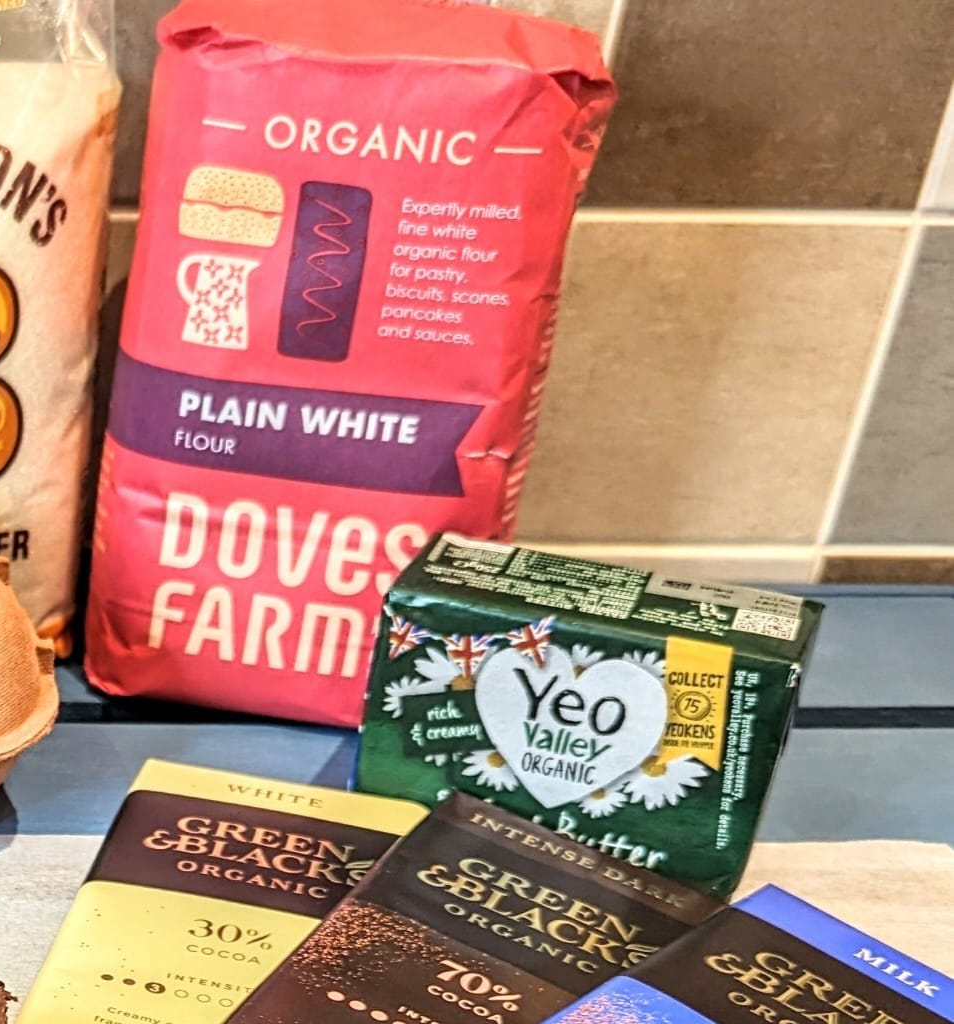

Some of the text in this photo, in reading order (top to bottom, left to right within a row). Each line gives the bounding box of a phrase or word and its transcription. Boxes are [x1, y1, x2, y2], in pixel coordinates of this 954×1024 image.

[264, 115, 476, 166] ORGANIC
[402, 198, 464, 220] Expertly
[398, 220, 477, 240] fine white
[390, 262, 410, 277] for
[393, 245, 498, 262] organic flour
[381, 307, 462, 324] pancakes
[378, 326, 411, 339] and
[179, 390, 421, 444] PLAIN WHITE
[174, 430, 236, 455] FLOUR
[148, 580, 374, 678] FARM
[668, 672, 724, 688] COLLECT
[734, 670, 746, 686] See
[427, 701, 463, 720] rich
[513, 667, 627, 737] Yeo
[426, 722, 483, 743] creamy
[523, 720, 614, 762] Valley
[738, 714, 755, 753] Purchase
[521, 752, 595, 785] ORGANIC
[227, 784, 323, 809] WHITE
[720, 797, 732, 811] for
[177, 816, 357, 863] GREEN
[555, 810, 668, 869] Btter
[470, 813, 686, 908] INTENSE DARK
[177, 860, 329, 899] ORGANIC
[459, 857, 643, 942] GREEN
[188, 918, 273, 950] 30%
[444, 903, 600, 974] ORGANIC
[186, 944, 261, 965] COCOA
[436, 959, 523, 1012] 70%
[854, 948, 941, 998] MILK
[427, 985, 504, 1024] COCOA
